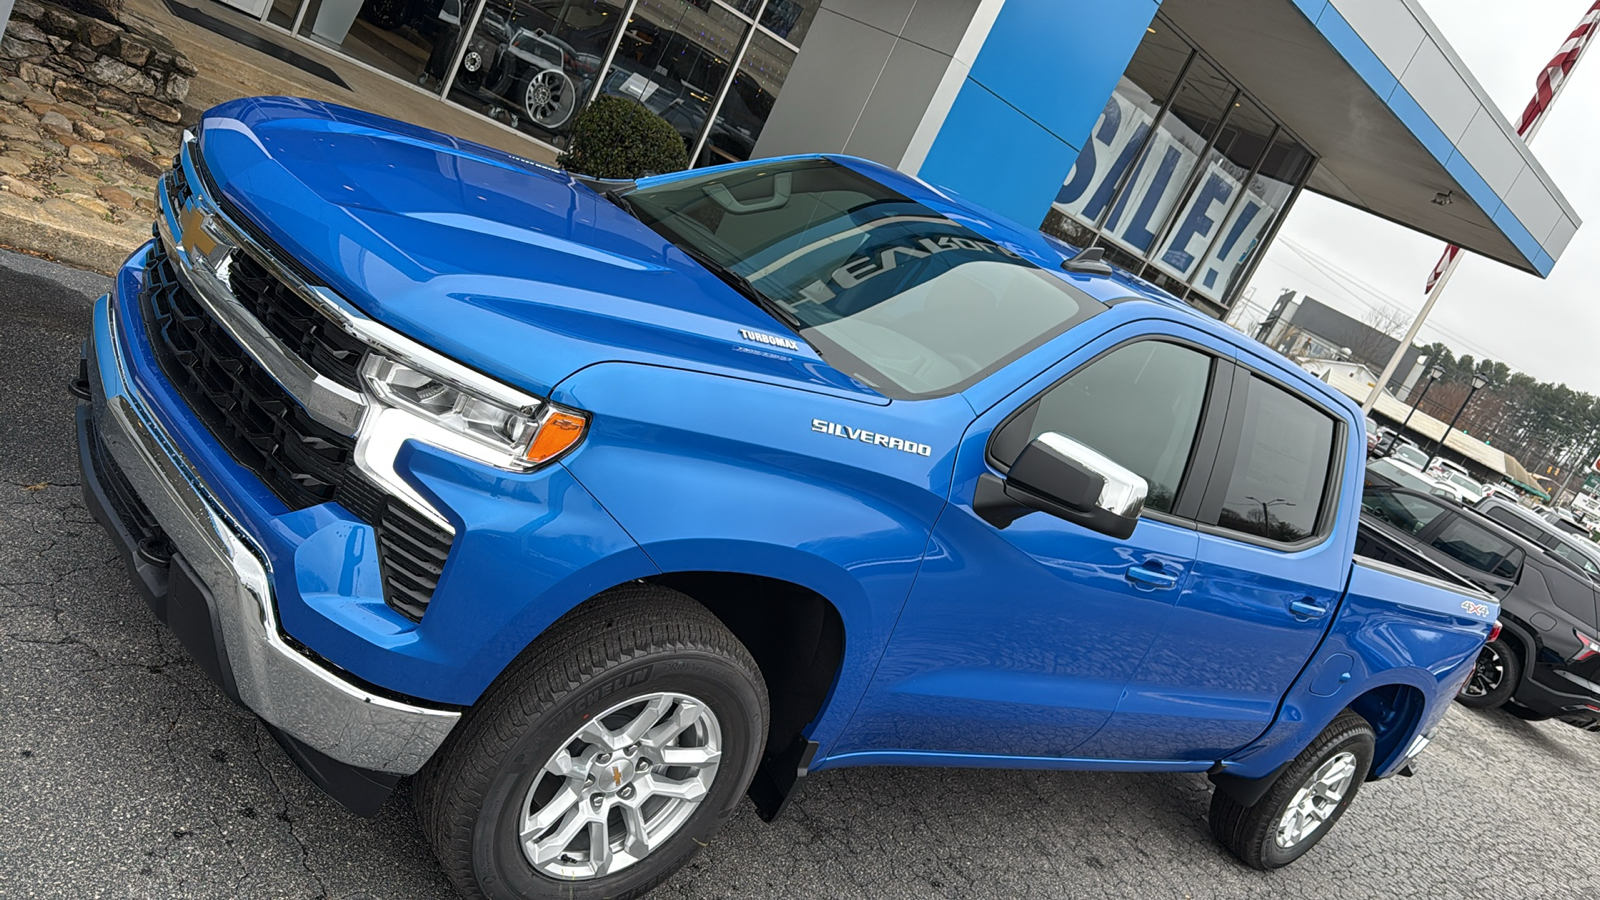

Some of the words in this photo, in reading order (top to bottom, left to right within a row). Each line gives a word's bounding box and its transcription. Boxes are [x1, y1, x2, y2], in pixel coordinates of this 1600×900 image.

[1055, 95, 1261, 290] SALE!
[739, 328, 799, 351] TURBOMAX
[811, 418, 932, 457] SILVERADO
[548, 667, 649, 733] MICHELIN
